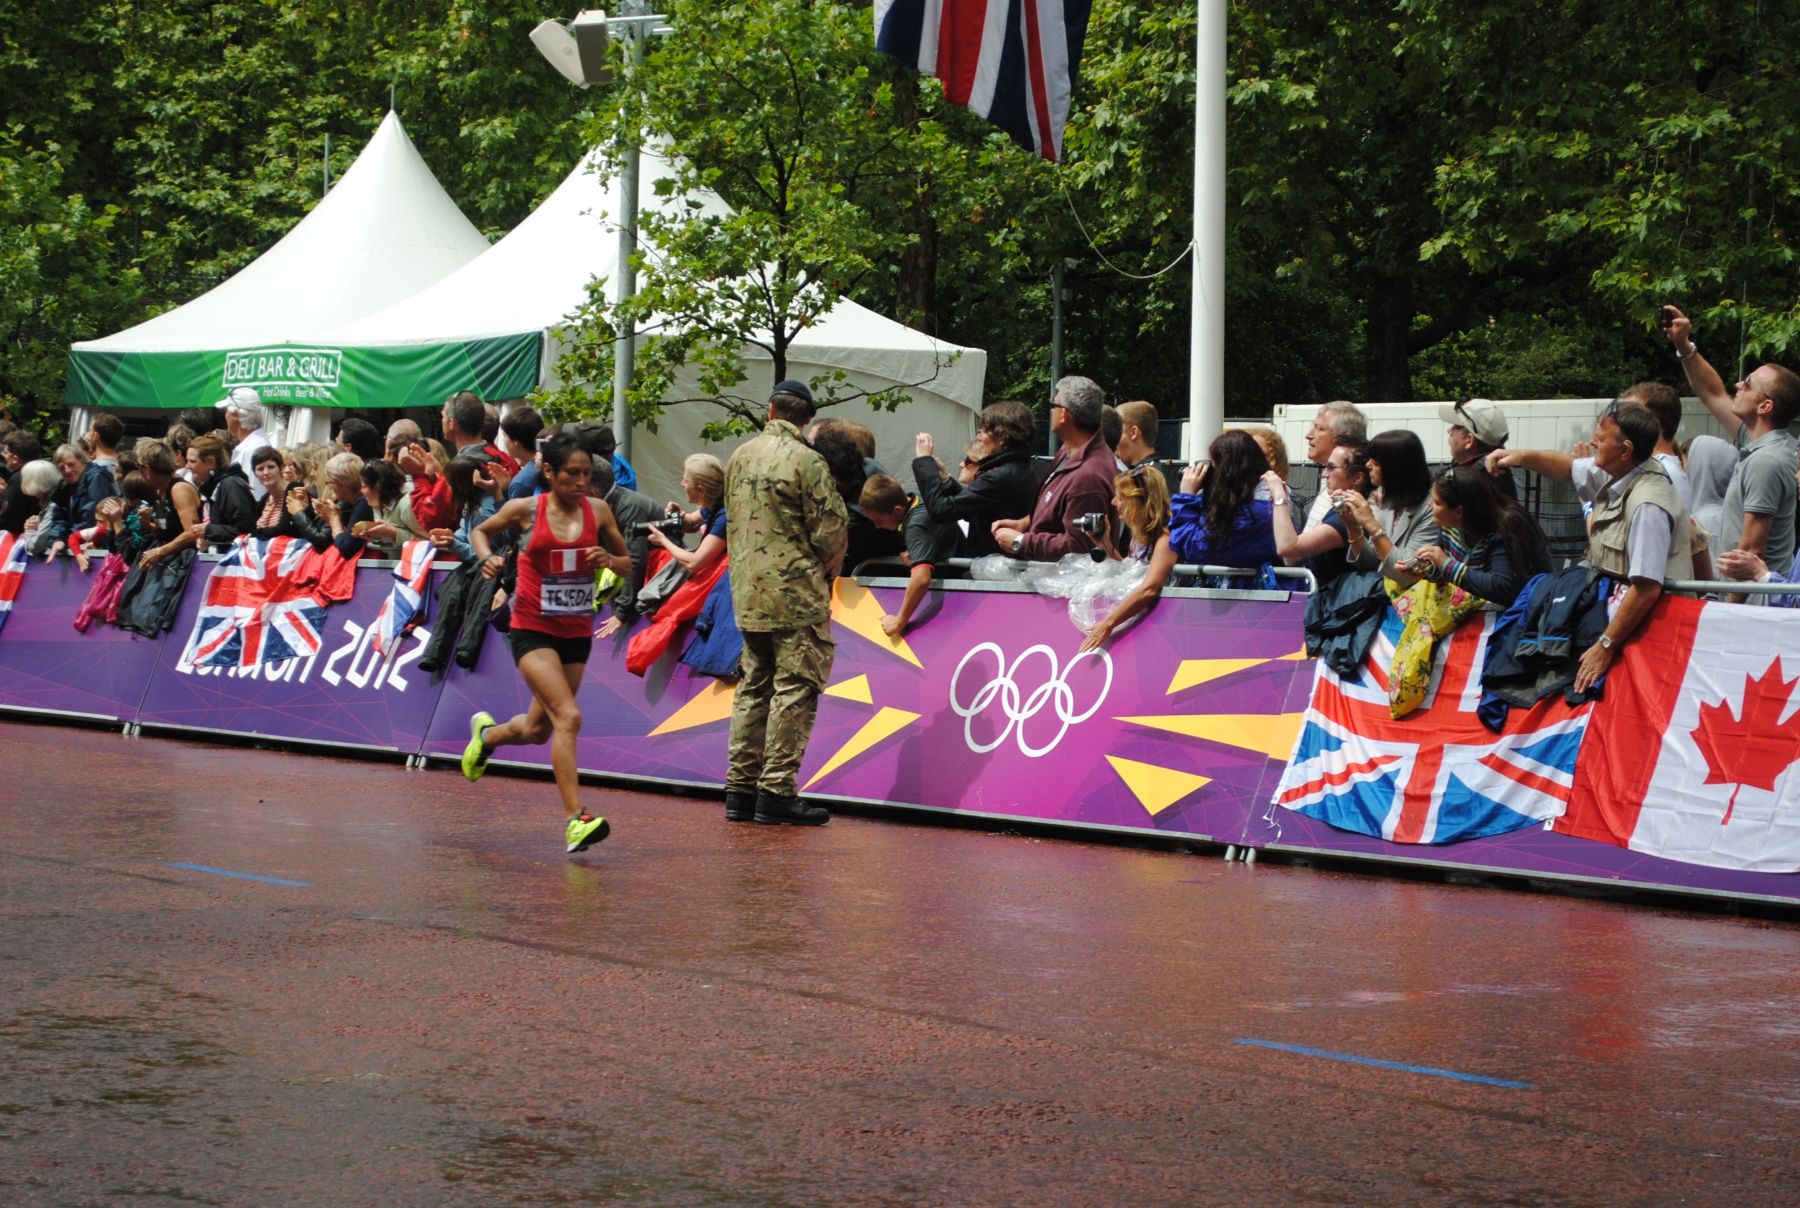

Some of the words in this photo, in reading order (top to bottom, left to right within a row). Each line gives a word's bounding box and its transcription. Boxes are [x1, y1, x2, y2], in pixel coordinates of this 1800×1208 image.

[226, 358, 256, 380] DELI
[257, 356, 284, 378] BAR
[286, 357, 296, 378] &
[299, 356, 335, 379] GRILL
[545, 588, 593, 607] TEJEDA
[321, 619, 432, 692] 2012
